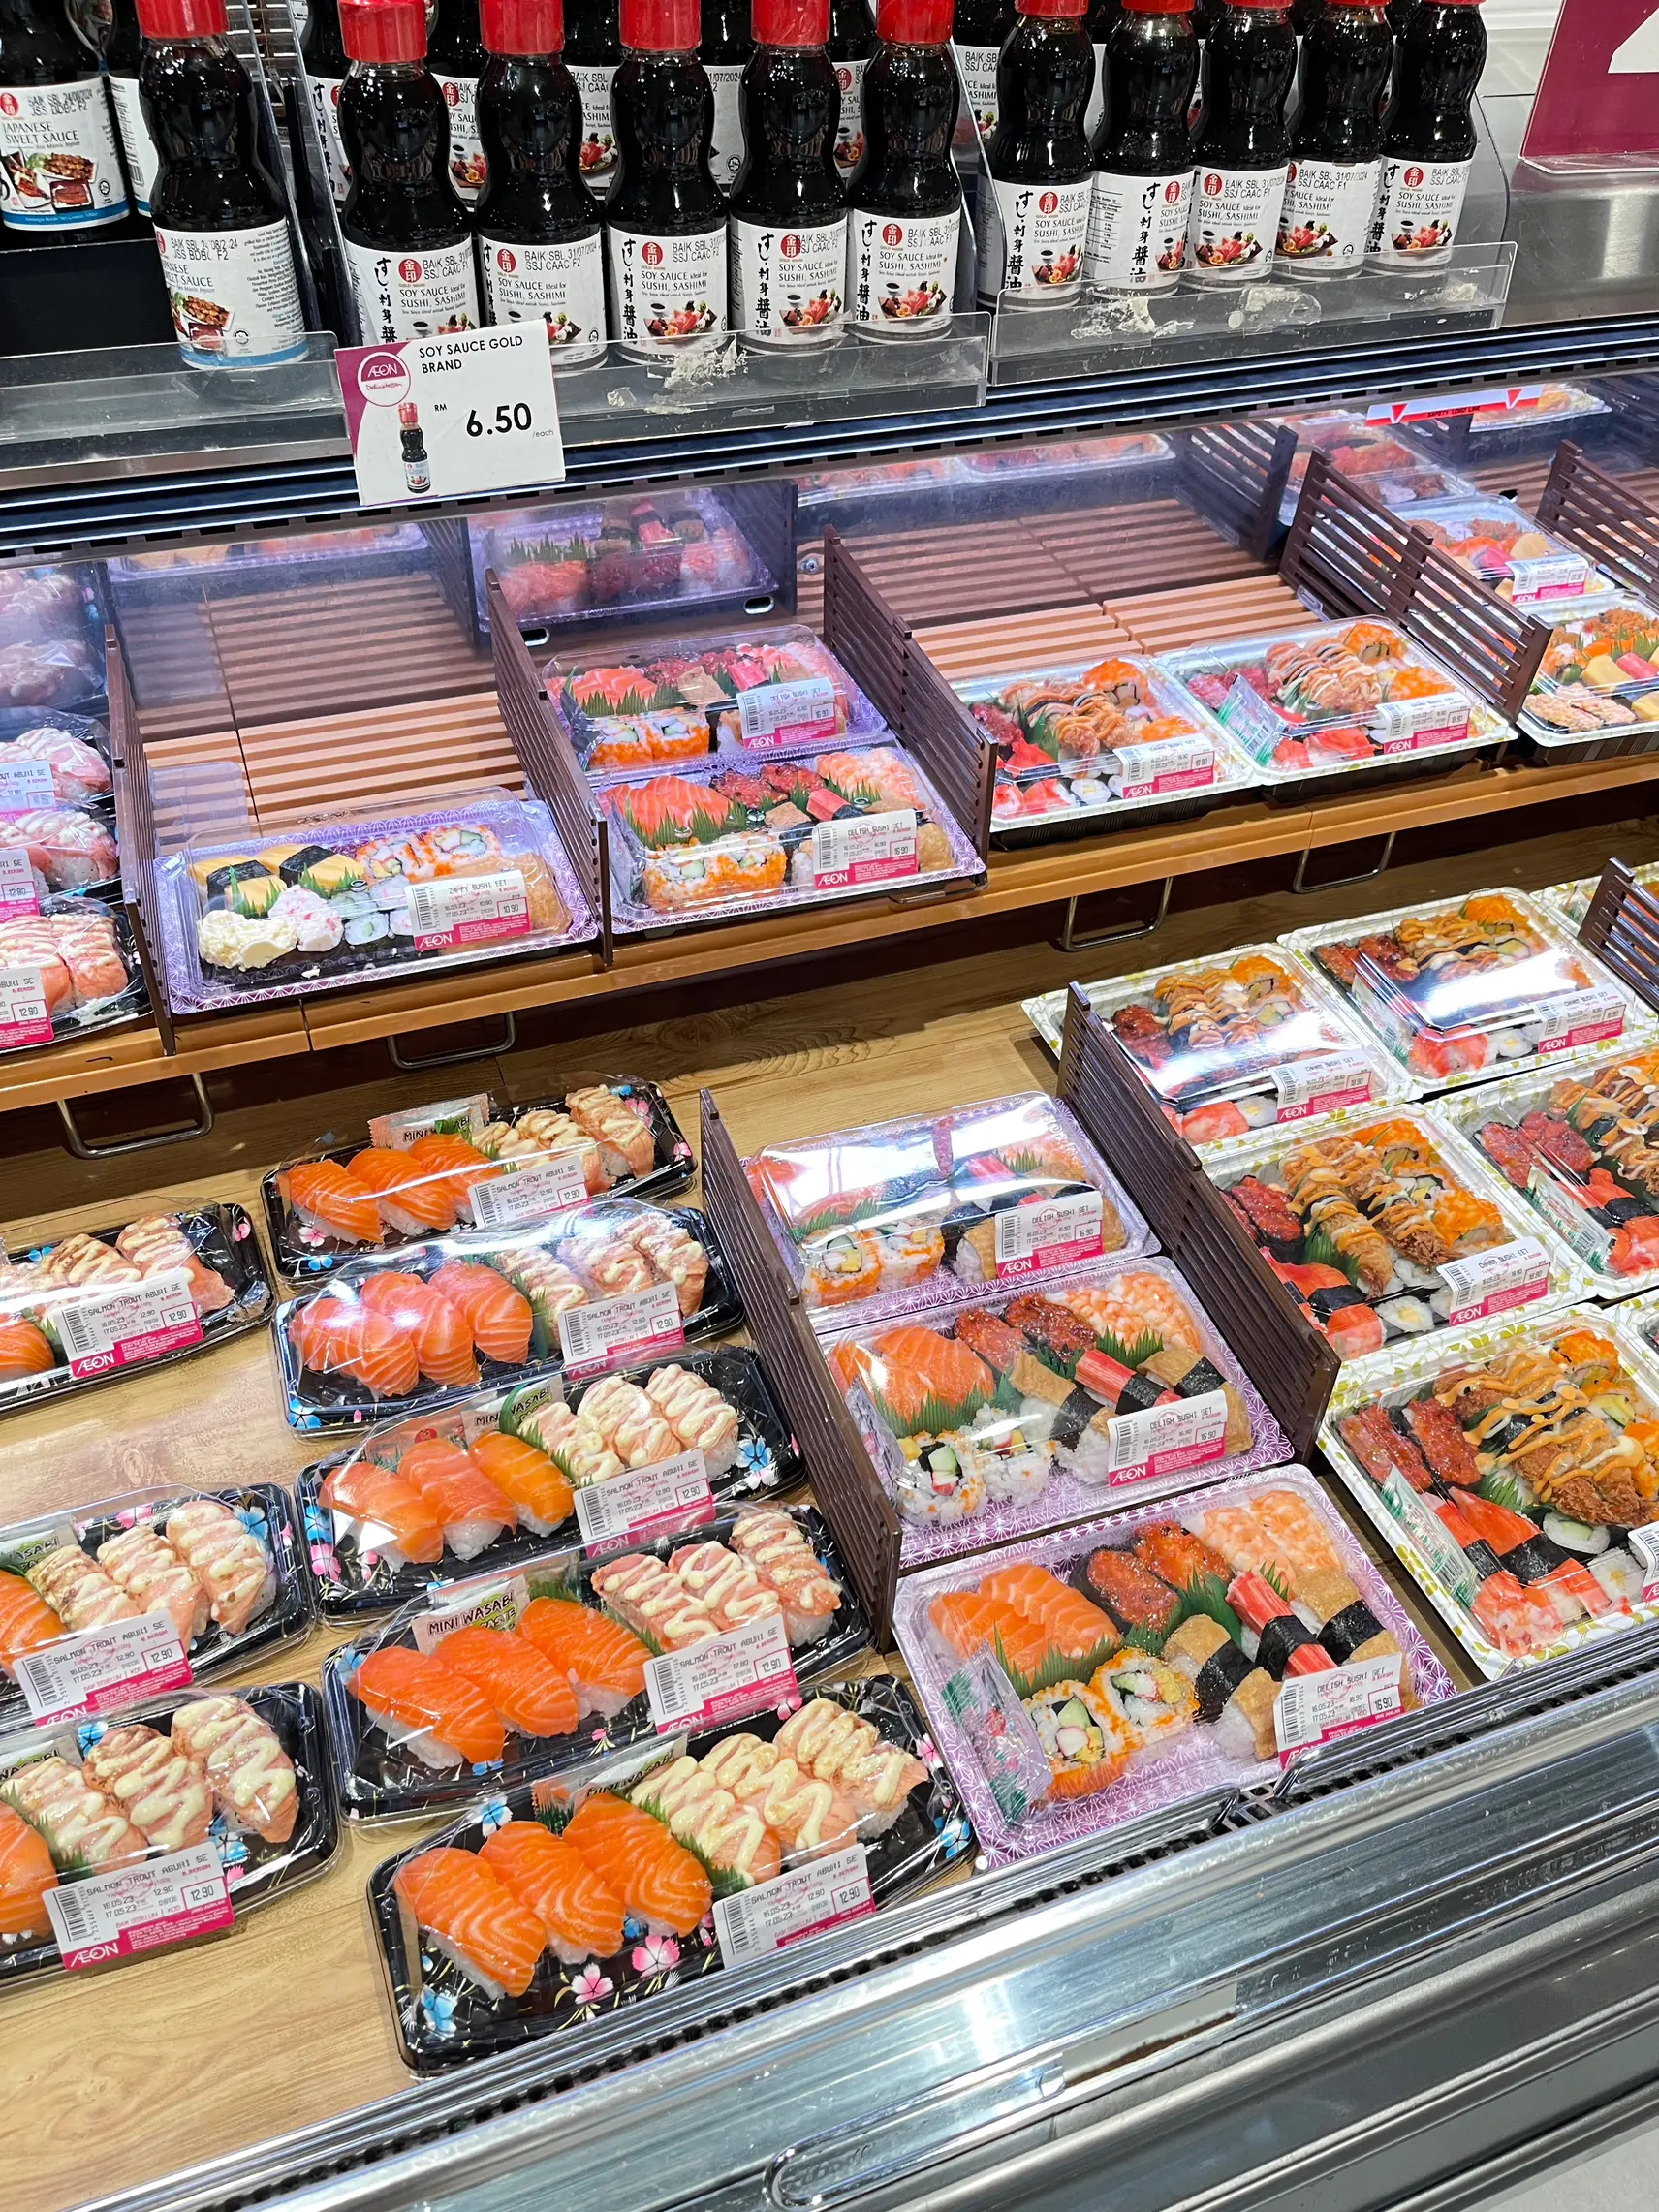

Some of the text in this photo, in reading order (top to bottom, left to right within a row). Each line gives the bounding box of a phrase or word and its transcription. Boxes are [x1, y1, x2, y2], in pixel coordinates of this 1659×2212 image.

[2, 122, 53, 134] JAPANESE
[5, 130, 79, 144] SWEET SAUCE
[1299, 169, 1333, 181] BAIK SBL
[1298, 178, 1347, 190] SSJ CAAC F1
[1290, 189, 1313, 201] SAUCE
[1199, 200, 1241, 211] SOY SAUCE
[1299, 202, 1332, 210] SASHIMI
[1396, 201, 1423, 210] SUSHI,
[1198, 208, 1223, 220] SUSHI,
[1035, 218, 1075, 229] SOY SAUCE
[672, 242, 692, 253] BAIK
[217, 249, 229, 260] F2
[524, 251, 565, 261] BAIK SBL
[673, 250, 711, 263] SSJ CAAC
[897, 253, 924, 262] SAUCE
[525, 258, 581, 271] SSJ CAAC F2
[779, 262, 824, 272] SOY SAUCE
[879, 261, 942, 270] SUSHI, SASHIMI
[641, 270, 688, 281] SOY SAUCE
[779, 273, 807, 282] SUSHI,
[181, 277, 213, 287] SAUCE
[498, 277, 512, 288] SOY
[515, 280, 543, 290] SAUCE
[642, 279, 707, 292] SUSHI, SASHIMI
[399, 286, 448, 298] SOY SAUCE
[499, 288, 566, 300] SUSHI, SASHIMI
[401, 292, 465, 308] SUSHI, SASHIMI
[419, 335, 523, 358] SOY SAUCE GOLD
[422, 359, 463, 374] BRAND
[466, 402, 532, 437] 6.50
[472, 883, 492, 891] SUSHI
[22, 977, 35, 985] SE
[1177, 1413, 1197, 1422] SUSHI
[428, 1591, 514, 1635] MINI WASABI
[53, 1620, 166, 1665] SALMON TROUT ABURI SE
[680, 1627, 777, 1667] SALMON TROUT ABURI SE
[1317, 1679, 1344, 1693] DELISH
[1347, 1672, 1368, 1684] SUSHI
[86, 1854, 208, 1897] SALMON TROUT ABURI SE
[751, 1854, 858, 1904] SALMON TROUT ABURI SE
